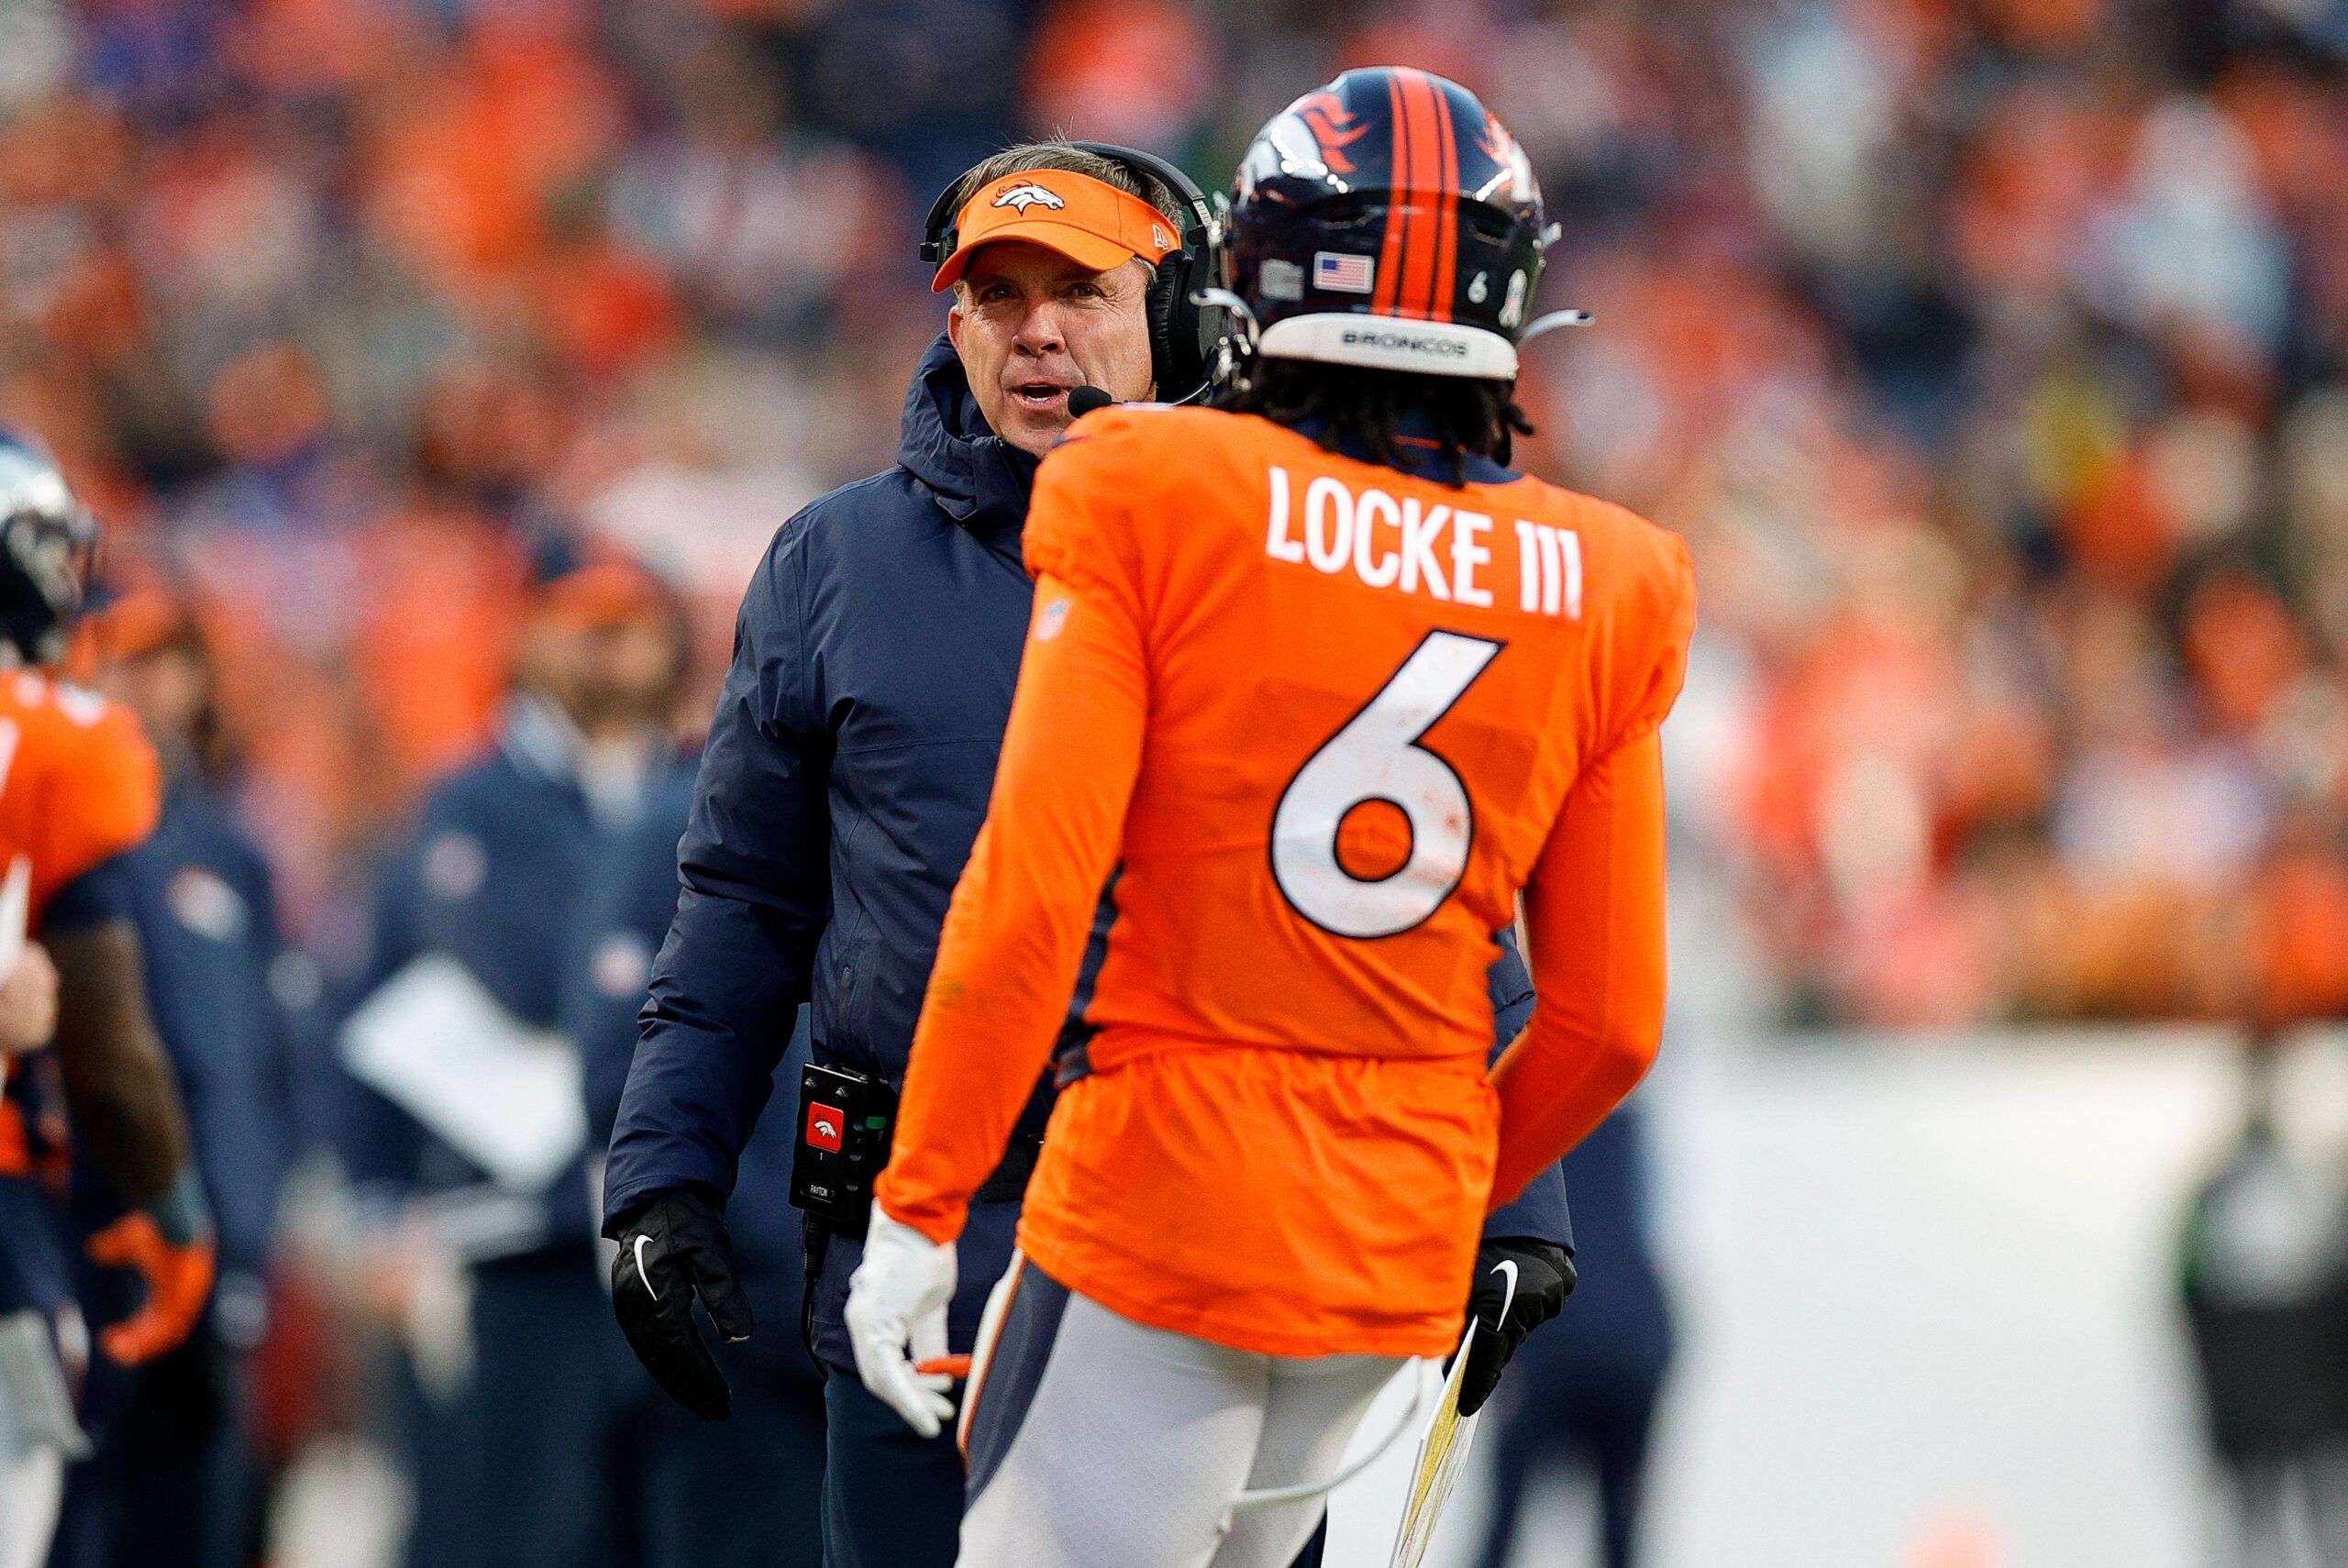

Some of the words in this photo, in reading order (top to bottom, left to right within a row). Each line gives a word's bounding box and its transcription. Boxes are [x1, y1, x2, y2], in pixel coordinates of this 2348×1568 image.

[1342, 329, 1468, 358] BRONCOS
[1266, 465, 1494, 609] LOCKE
[1513, 518, 1584, 622] III
[1269, 627, 1508, 940] 6
